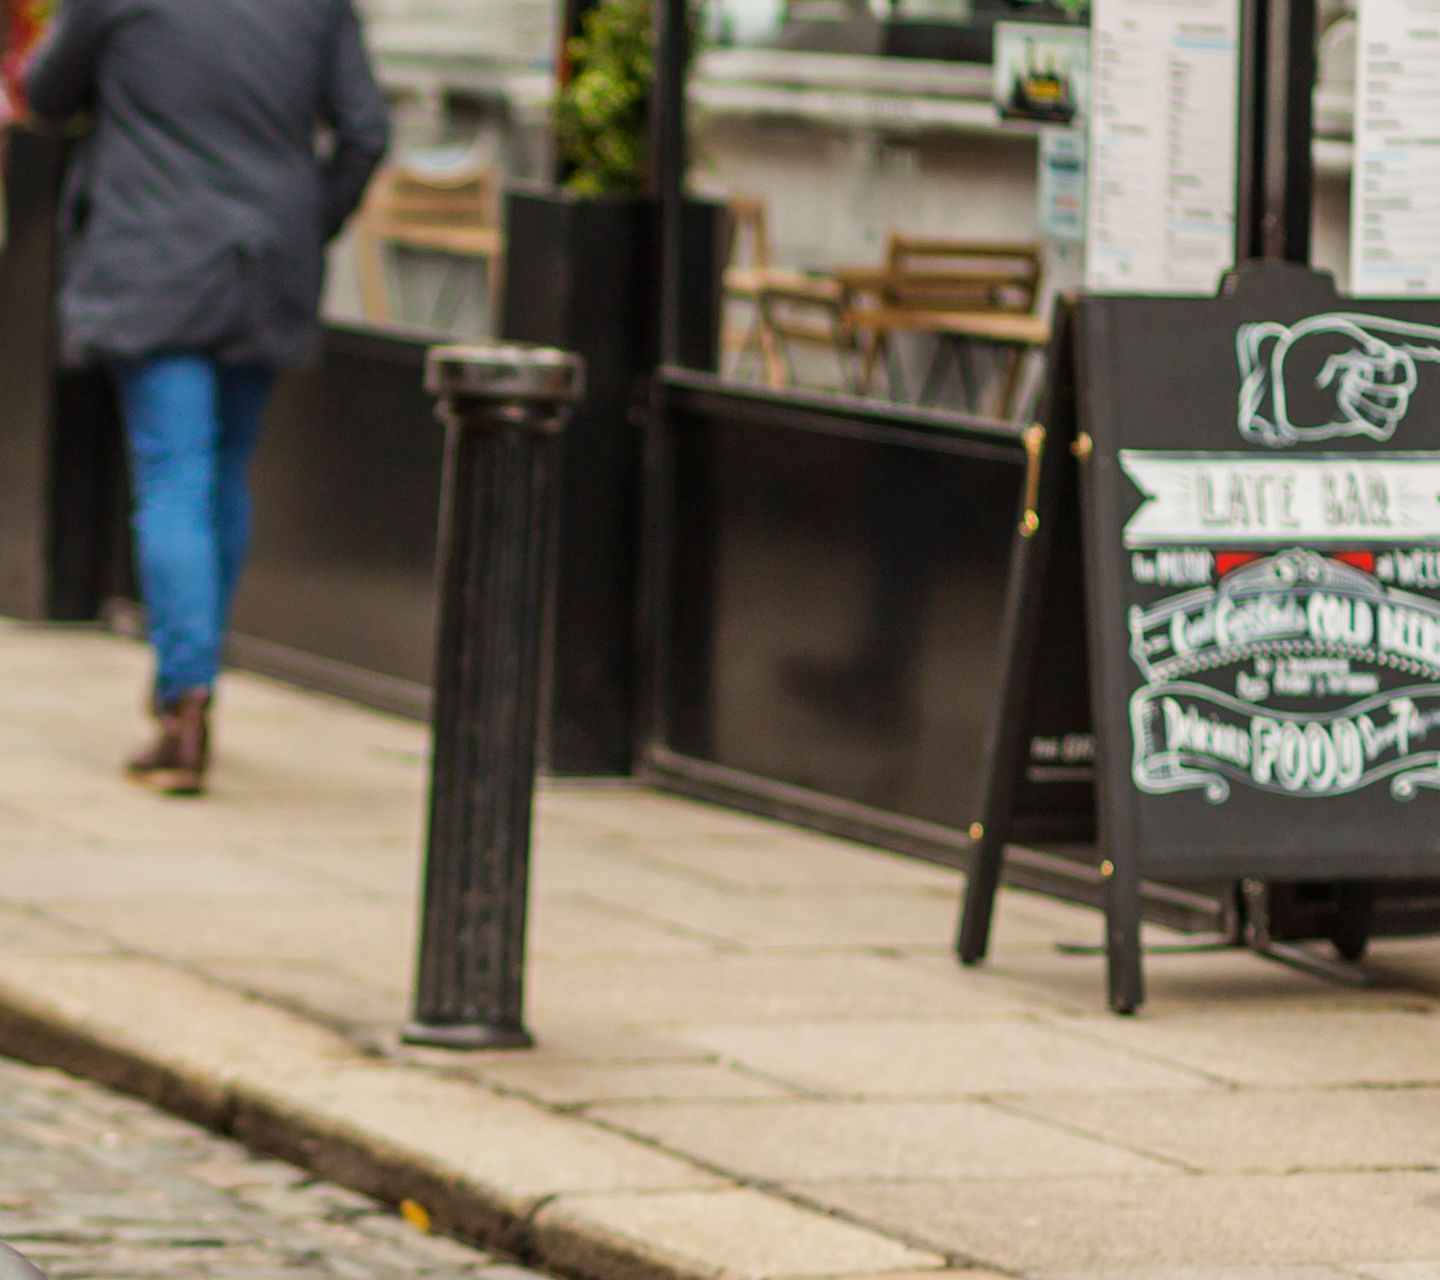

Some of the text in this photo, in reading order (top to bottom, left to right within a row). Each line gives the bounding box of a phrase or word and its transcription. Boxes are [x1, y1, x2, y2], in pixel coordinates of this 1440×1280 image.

[1197, 465, 1393, 529] LATE BAR
[1307, 591, 1373, 647] COLD
[1250, 715, 1365, 791] FOOD
